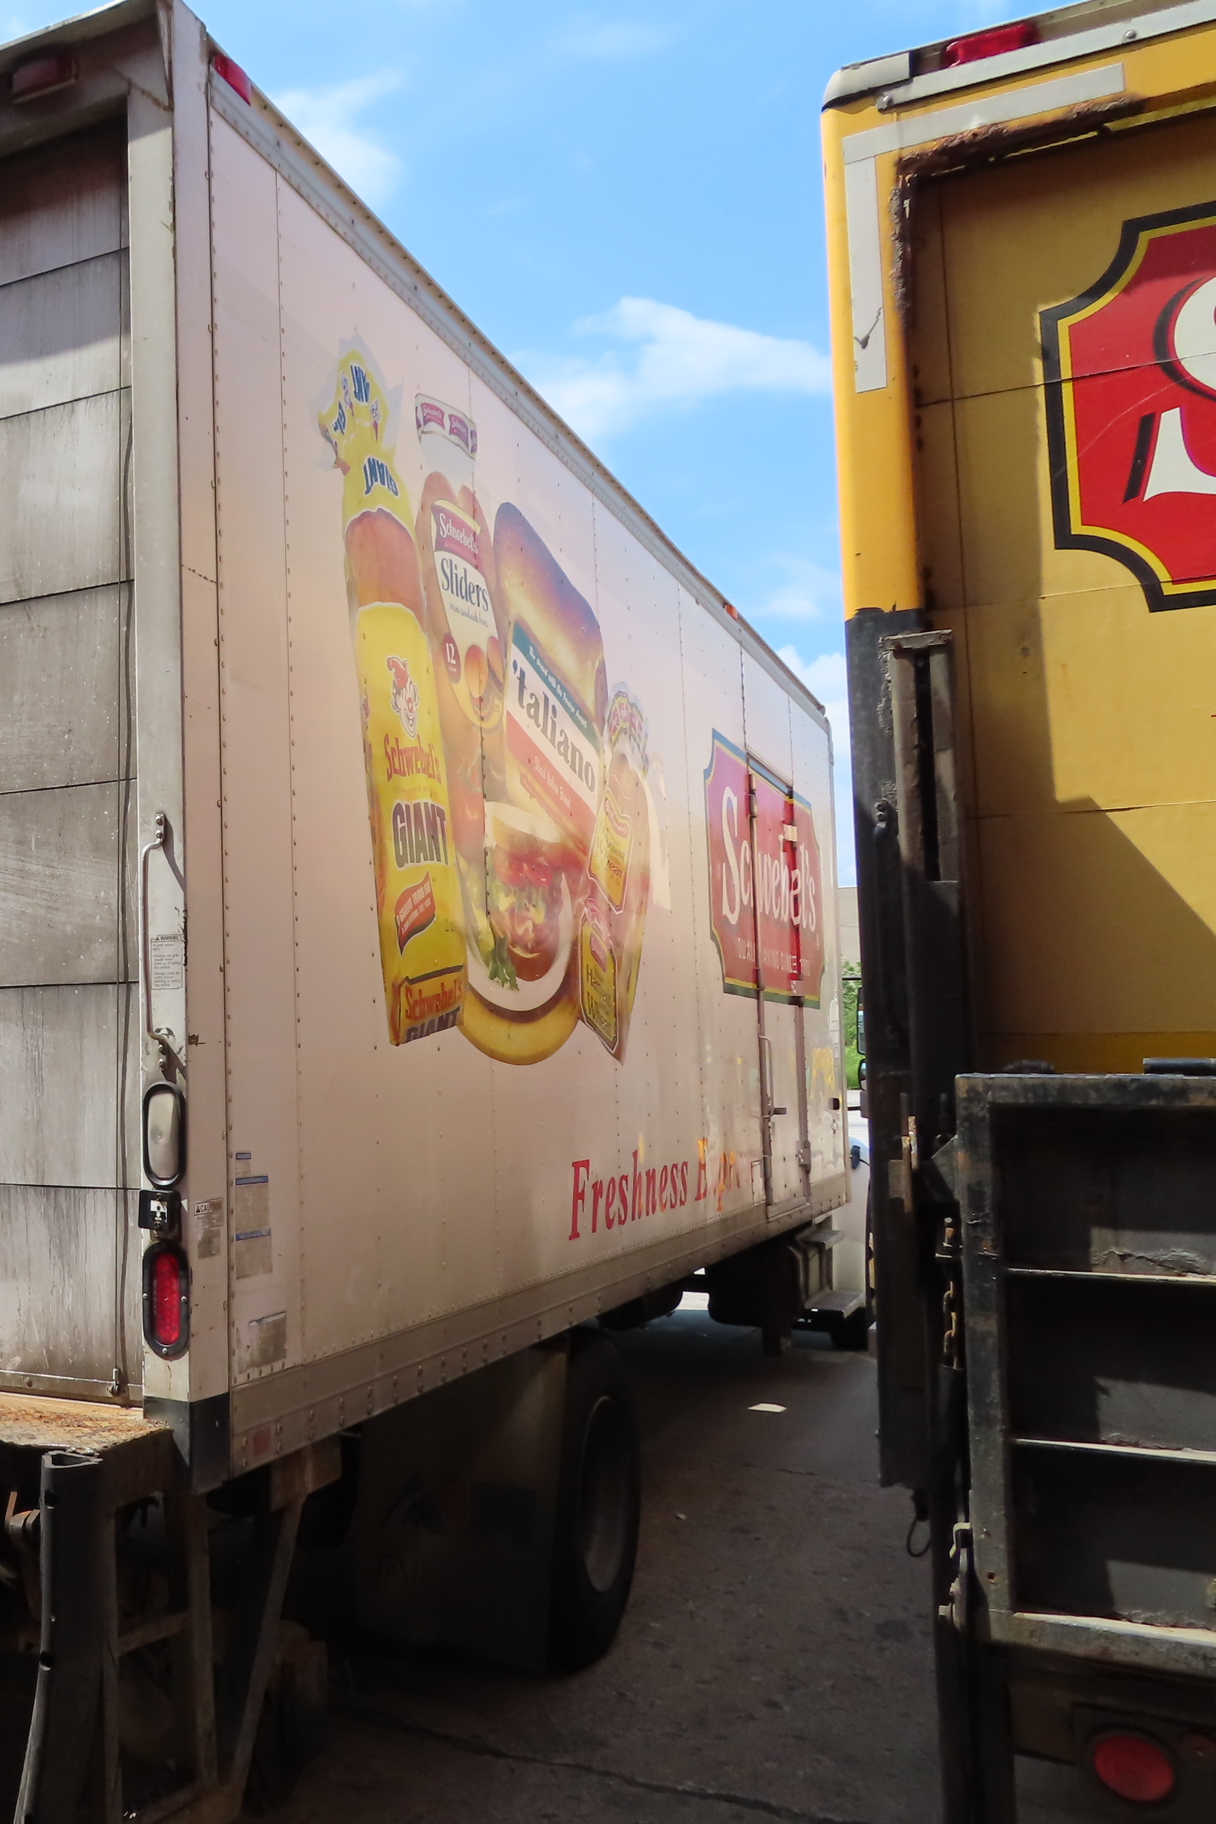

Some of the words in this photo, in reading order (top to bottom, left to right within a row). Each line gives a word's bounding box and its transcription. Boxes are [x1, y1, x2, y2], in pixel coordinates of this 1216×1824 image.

[439, 512, 479, 555] Schwebel's
[441, 557, 489, 612] Sliders
[445, 641, 457, 665] 12
[512, 659, 596, 793] 'taliano
[384, 733, 442, 785] Schwebel's
[392, 802, 449, 868] GIANT
[569, 1149, 689, 1241] Freshness
